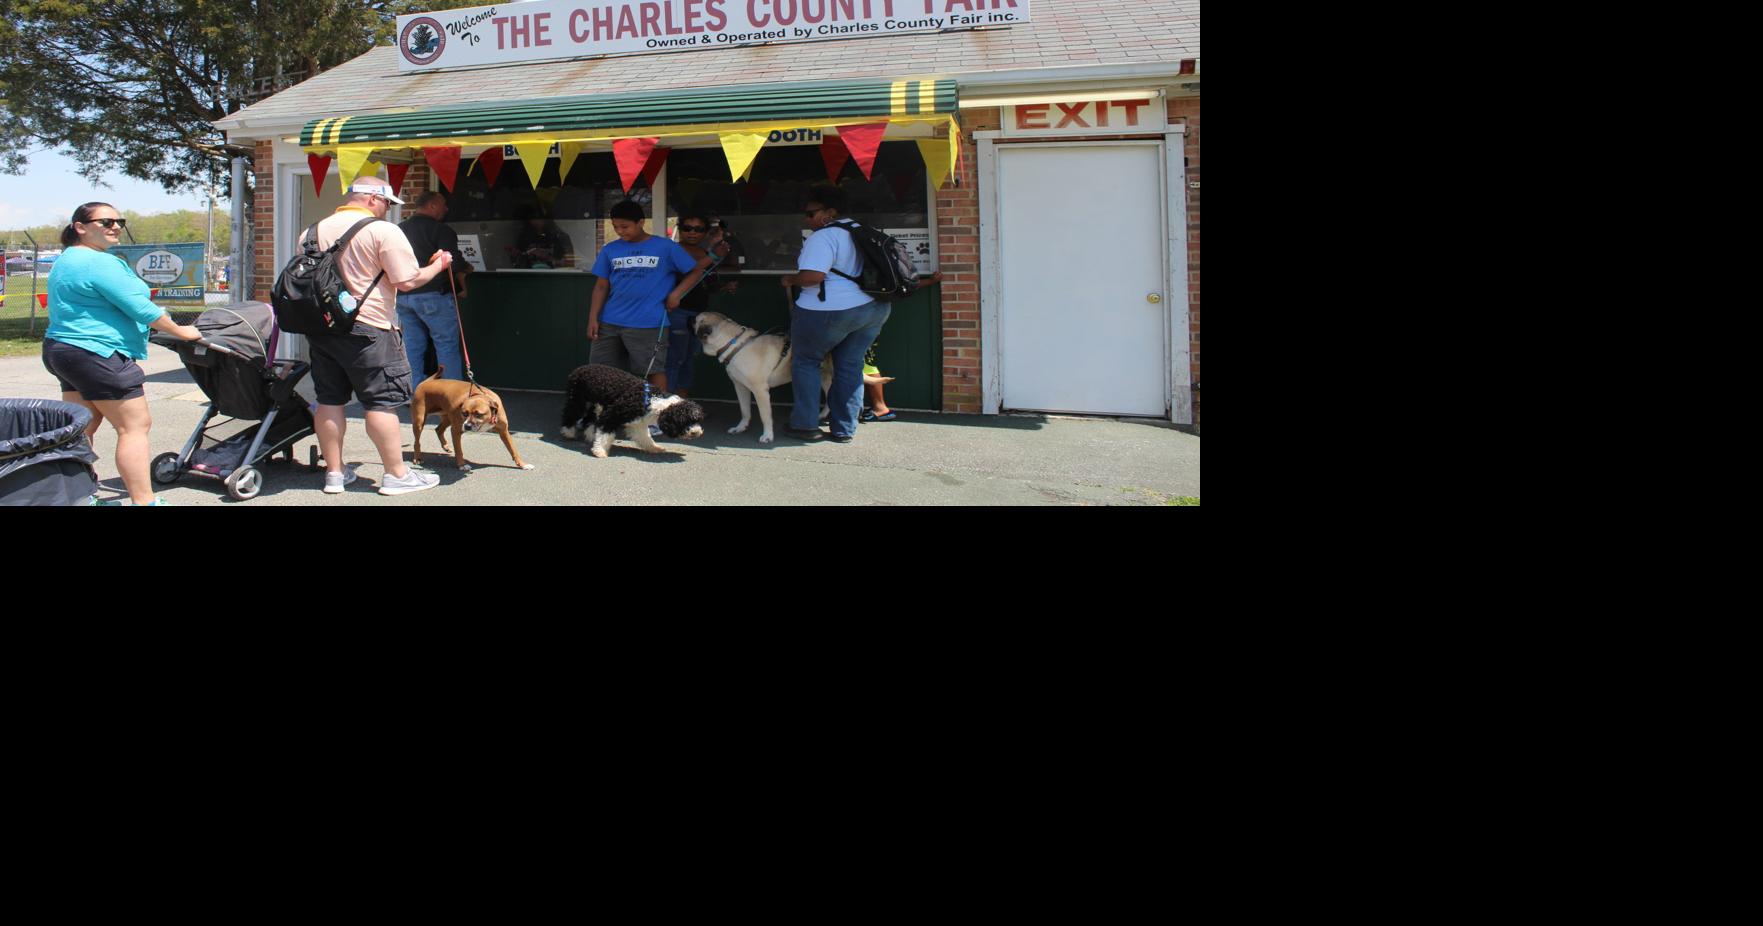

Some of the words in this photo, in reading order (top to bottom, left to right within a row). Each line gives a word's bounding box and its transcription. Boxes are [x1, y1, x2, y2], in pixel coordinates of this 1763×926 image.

[446, 7, 497, 35] Welcome
[492, 12, 552, 50] THE
[568, 0, 728, 43] CHARLES
[646, 36, 696, 48] Owned
[701, 34, 712, 44] &
[716, 29, 786, 43] Operated
[794, 27, 812, 38] by
[818, 22, 879, 35] Charles
[884, 17, 944, 29] County
[950, 14, 983, 25] Fair
[988, 12, 1019, 22] inc.
[461, 32, 480, 46] To
[1015, 99, 1150, 130] EXIT
[767, 127, 821, 143] OOTH
[148, 254, 172, 269] BFF
[163, 288, 201, 297] TRAINING
